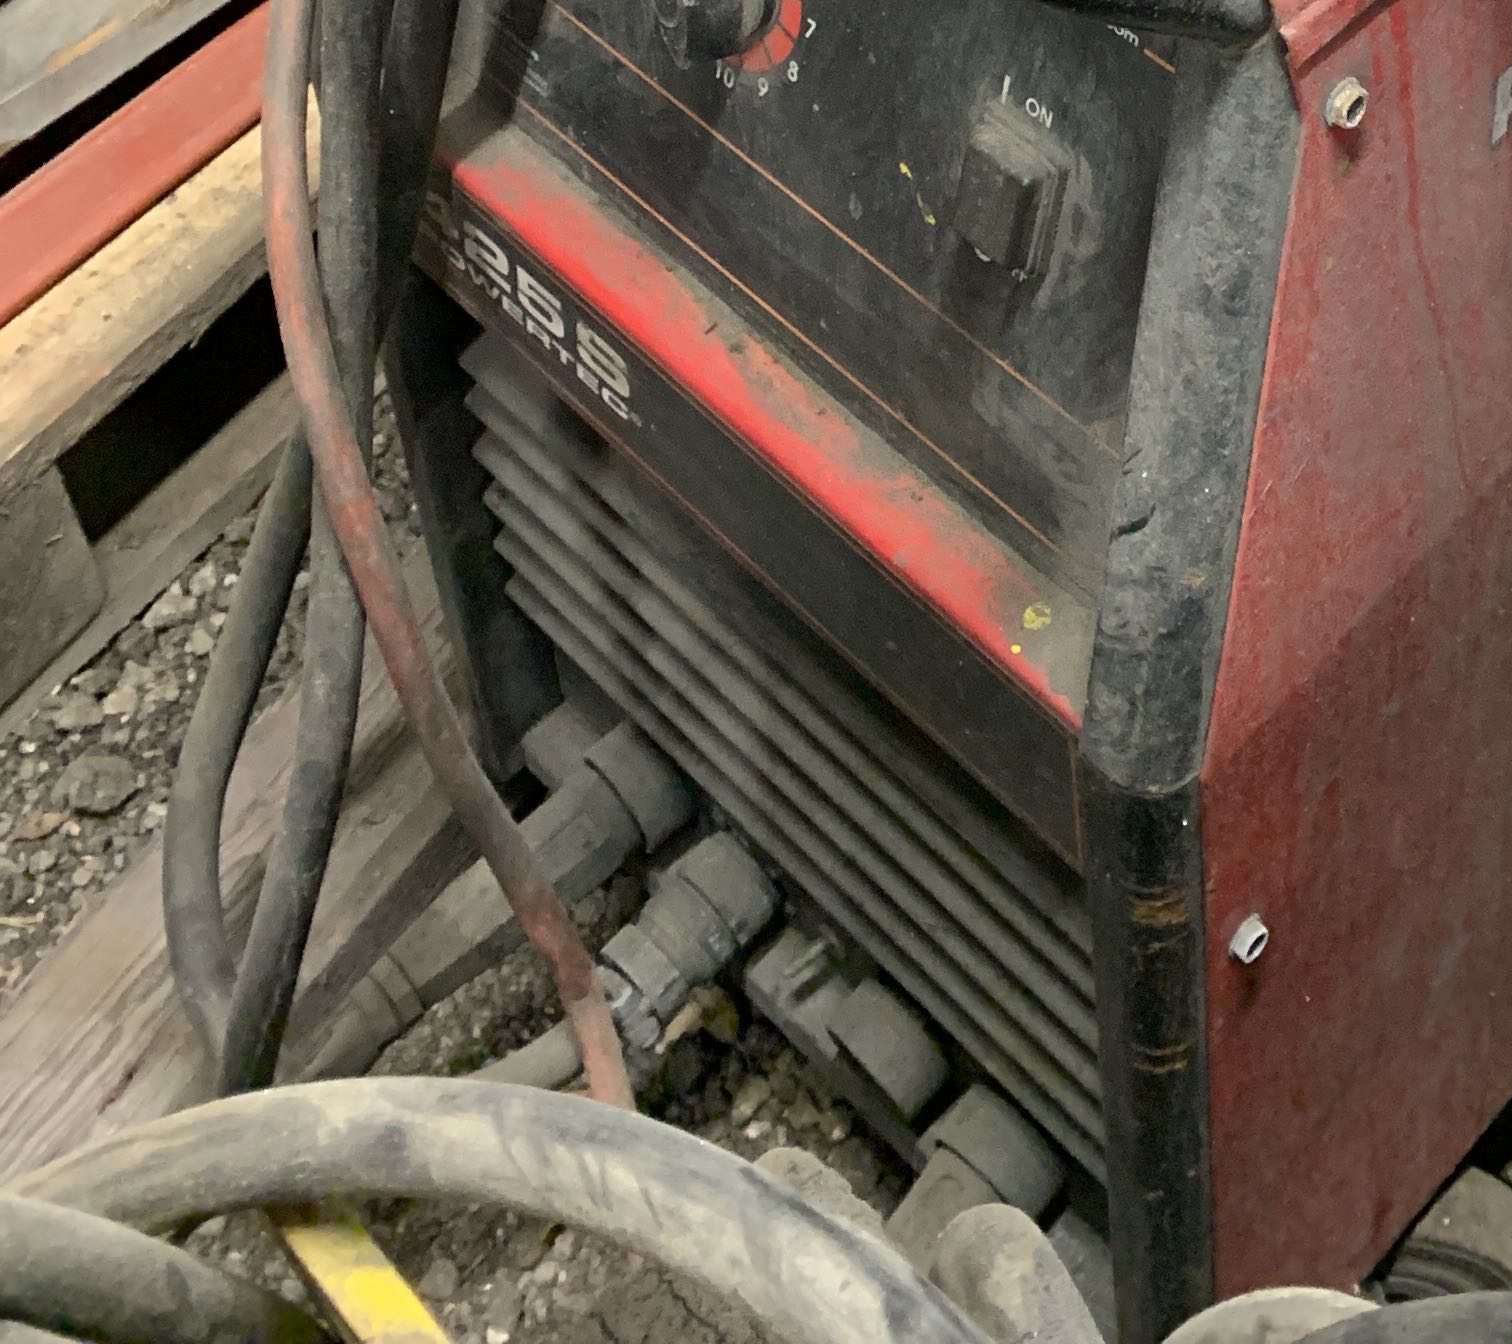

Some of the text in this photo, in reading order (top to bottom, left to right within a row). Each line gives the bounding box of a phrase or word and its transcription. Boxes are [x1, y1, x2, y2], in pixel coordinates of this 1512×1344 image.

[805, 18, 817, 38] 7
[715, 62, 735, 89] 10
[787, 61, 799, 83] 8
[757, 77, 769, 97] 9
[1025, 97, 1053, 129] ON
